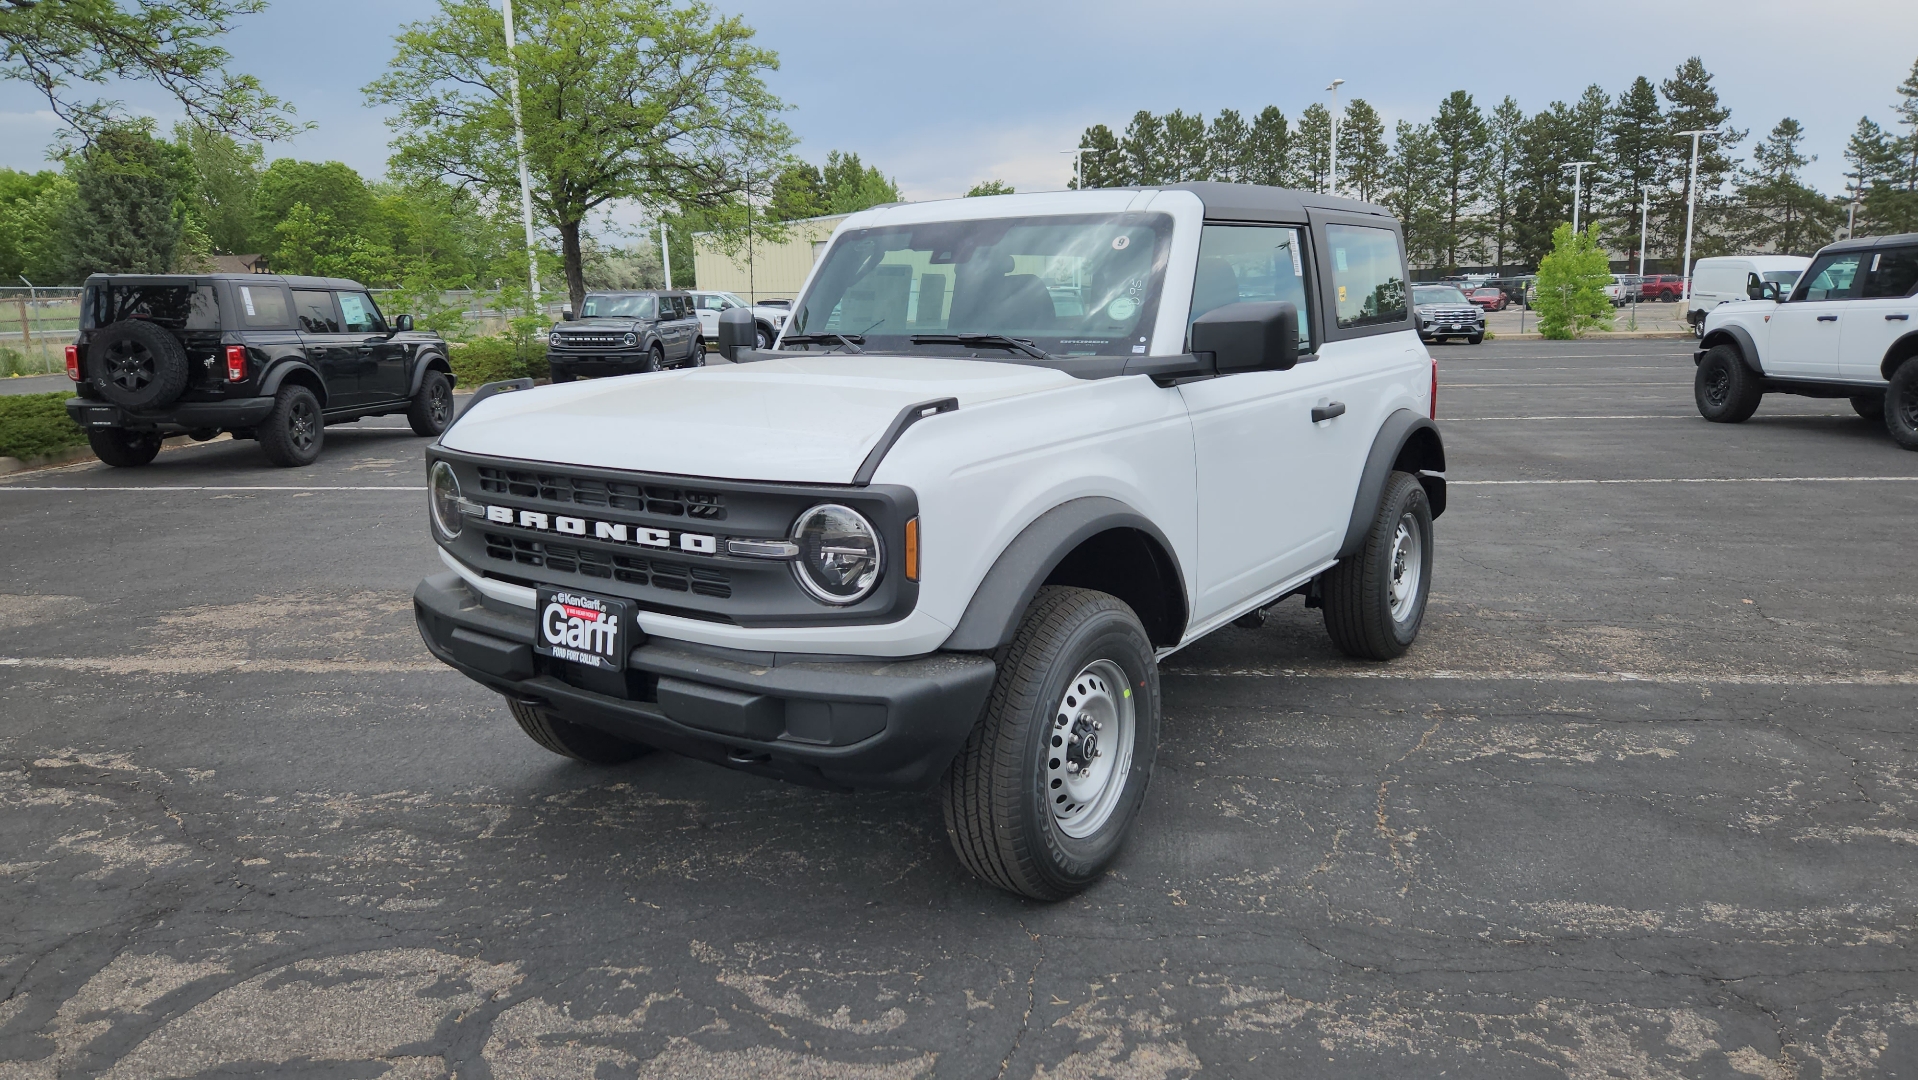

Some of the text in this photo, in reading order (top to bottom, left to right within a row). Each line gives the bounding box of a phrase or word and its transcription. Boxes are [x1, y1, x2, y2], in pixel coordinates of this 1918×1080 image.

[487, 505, 717, 553] BRONCO
[543, 602, 618, 656] Garff
[552, 646, 600, 667] FORD FORT COLLINS
